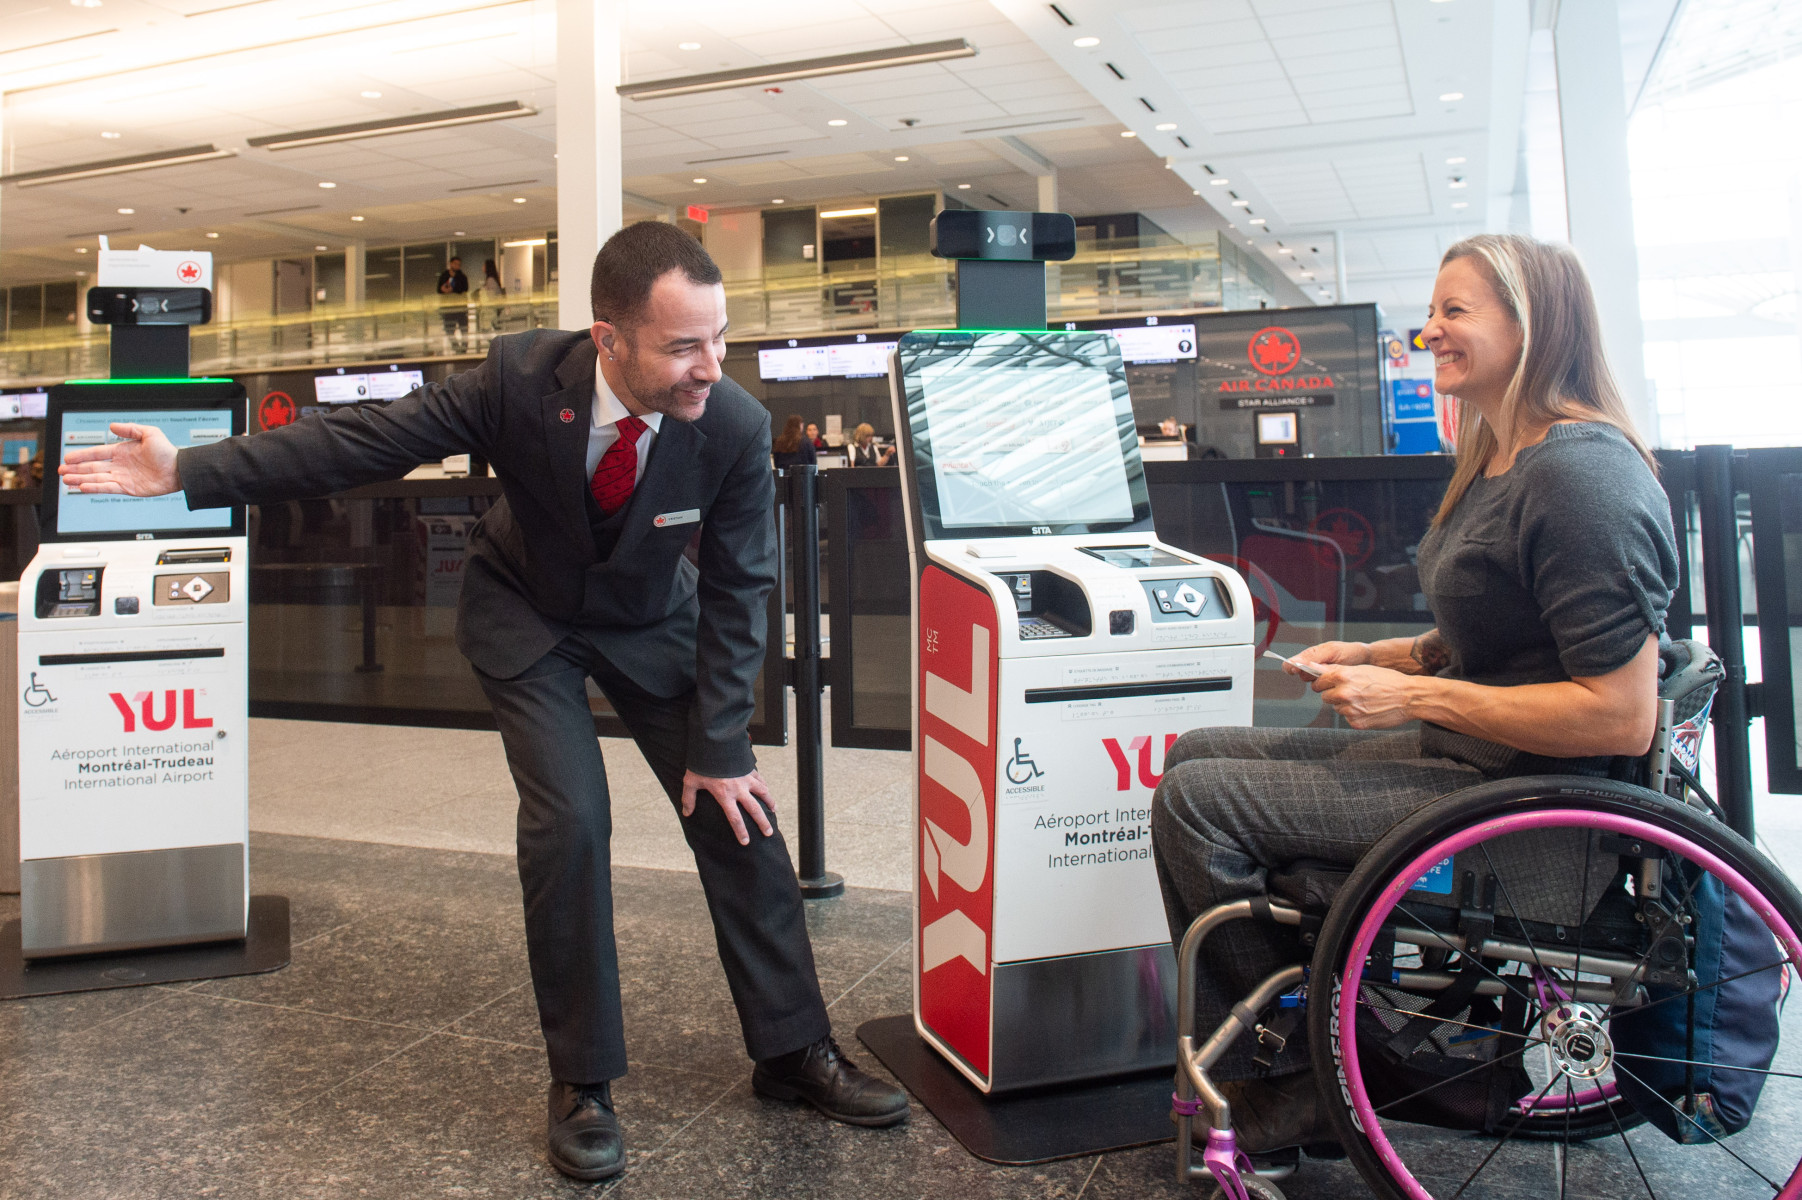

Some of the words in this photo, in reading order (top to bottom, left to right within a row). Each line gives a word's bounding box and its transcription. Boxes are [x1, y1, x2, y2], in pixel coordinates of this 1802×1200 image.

[1219, 379, 1250, 393] AIR
[1254, 375, 1335, 391] CANADA
[1237, 398, 1261, 408] STAR
[1263, 397, 1307, 408] ALLIANCE
[1031, 526, 1052, 535] SITA
[108, 688, 214, 733] YUL
[50, 746, 117, 761] Aéroport
[123, 739, 214, 757] International
[78, 756, 214, 774] Montréal-Trudeau
[1101, 733, 1178, 792] YU
[64, 774, 157, 790] International
[162, 770, 214, 787] Airport
[1005, 784, 1045, 795] ACCESSIBLE
[923, 623, 989, 976] YUL
[1034, 809, 1110, 830] Aéroport
[1116, 808, 1152, 822] Inter
[1065, 825, 1152, 847] Montréal-
[1048, 843, 1152, 868] International
